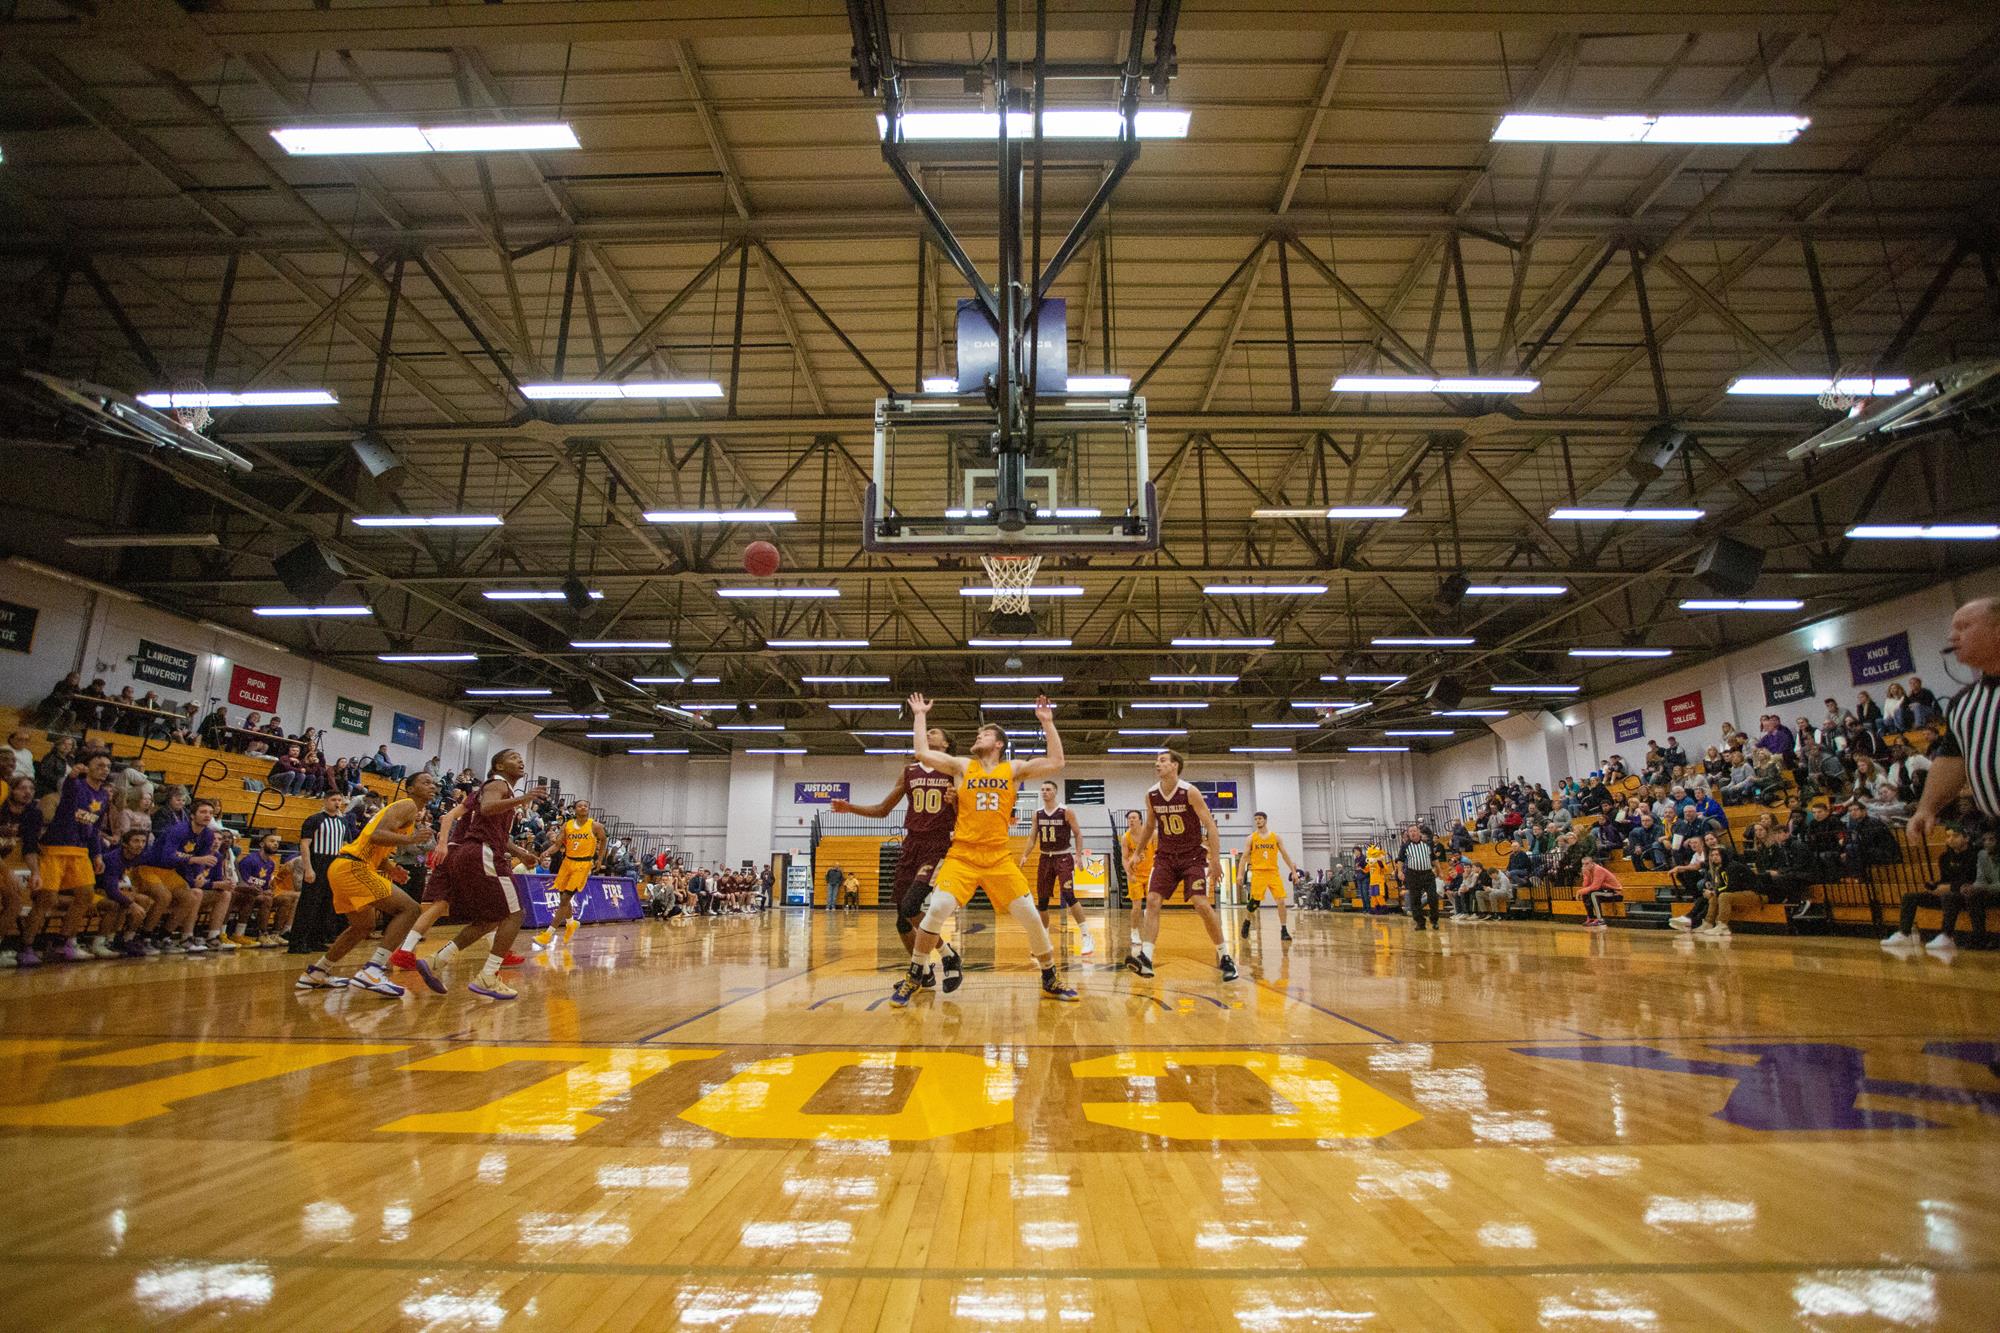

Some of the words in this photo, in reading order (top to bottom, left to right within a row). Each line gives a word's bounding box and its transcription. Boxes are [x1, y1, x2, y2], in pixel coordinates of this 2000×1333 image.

[146, 650, 189, 669] LAWRENCE
[1866, 646, 1889, 660] KNOX
[141, 664, 188, 683] UNIVERSITY
[1862, 660, 1901, 677] COLLEGE
[246, 677, 266, 689] RIPON
[1772, 671, 1801, 685] ILLINOIS
[239, 690, 269, 705] COLLEGE
[1773, 684, 1804, 699] COLLEGE
[347, 706, 370, 718] NORBERT
[1671, 701, 1695, 713] GRINNELL
[341, 716, 363, 728] COLLEGE
[1672, 713, 1697, 725] COLLEGE
[1620, 727, 1639, 738] COLLEGE
[803, 784, 820, 792] JUST
[821, 784, 832, 792] DO
[833, 784, 841, 792] IT.
[967, 778, 1009, 790] KNOX
[912, 788, 942, 814] 00
[976, 792, 999, 812] 23
[1160, 814, 1185, 835] 10
[1041, 826, 1057, 842] 11
[573, 841, 580, 851] 3
[602, 884, 625, 900] FIRE
